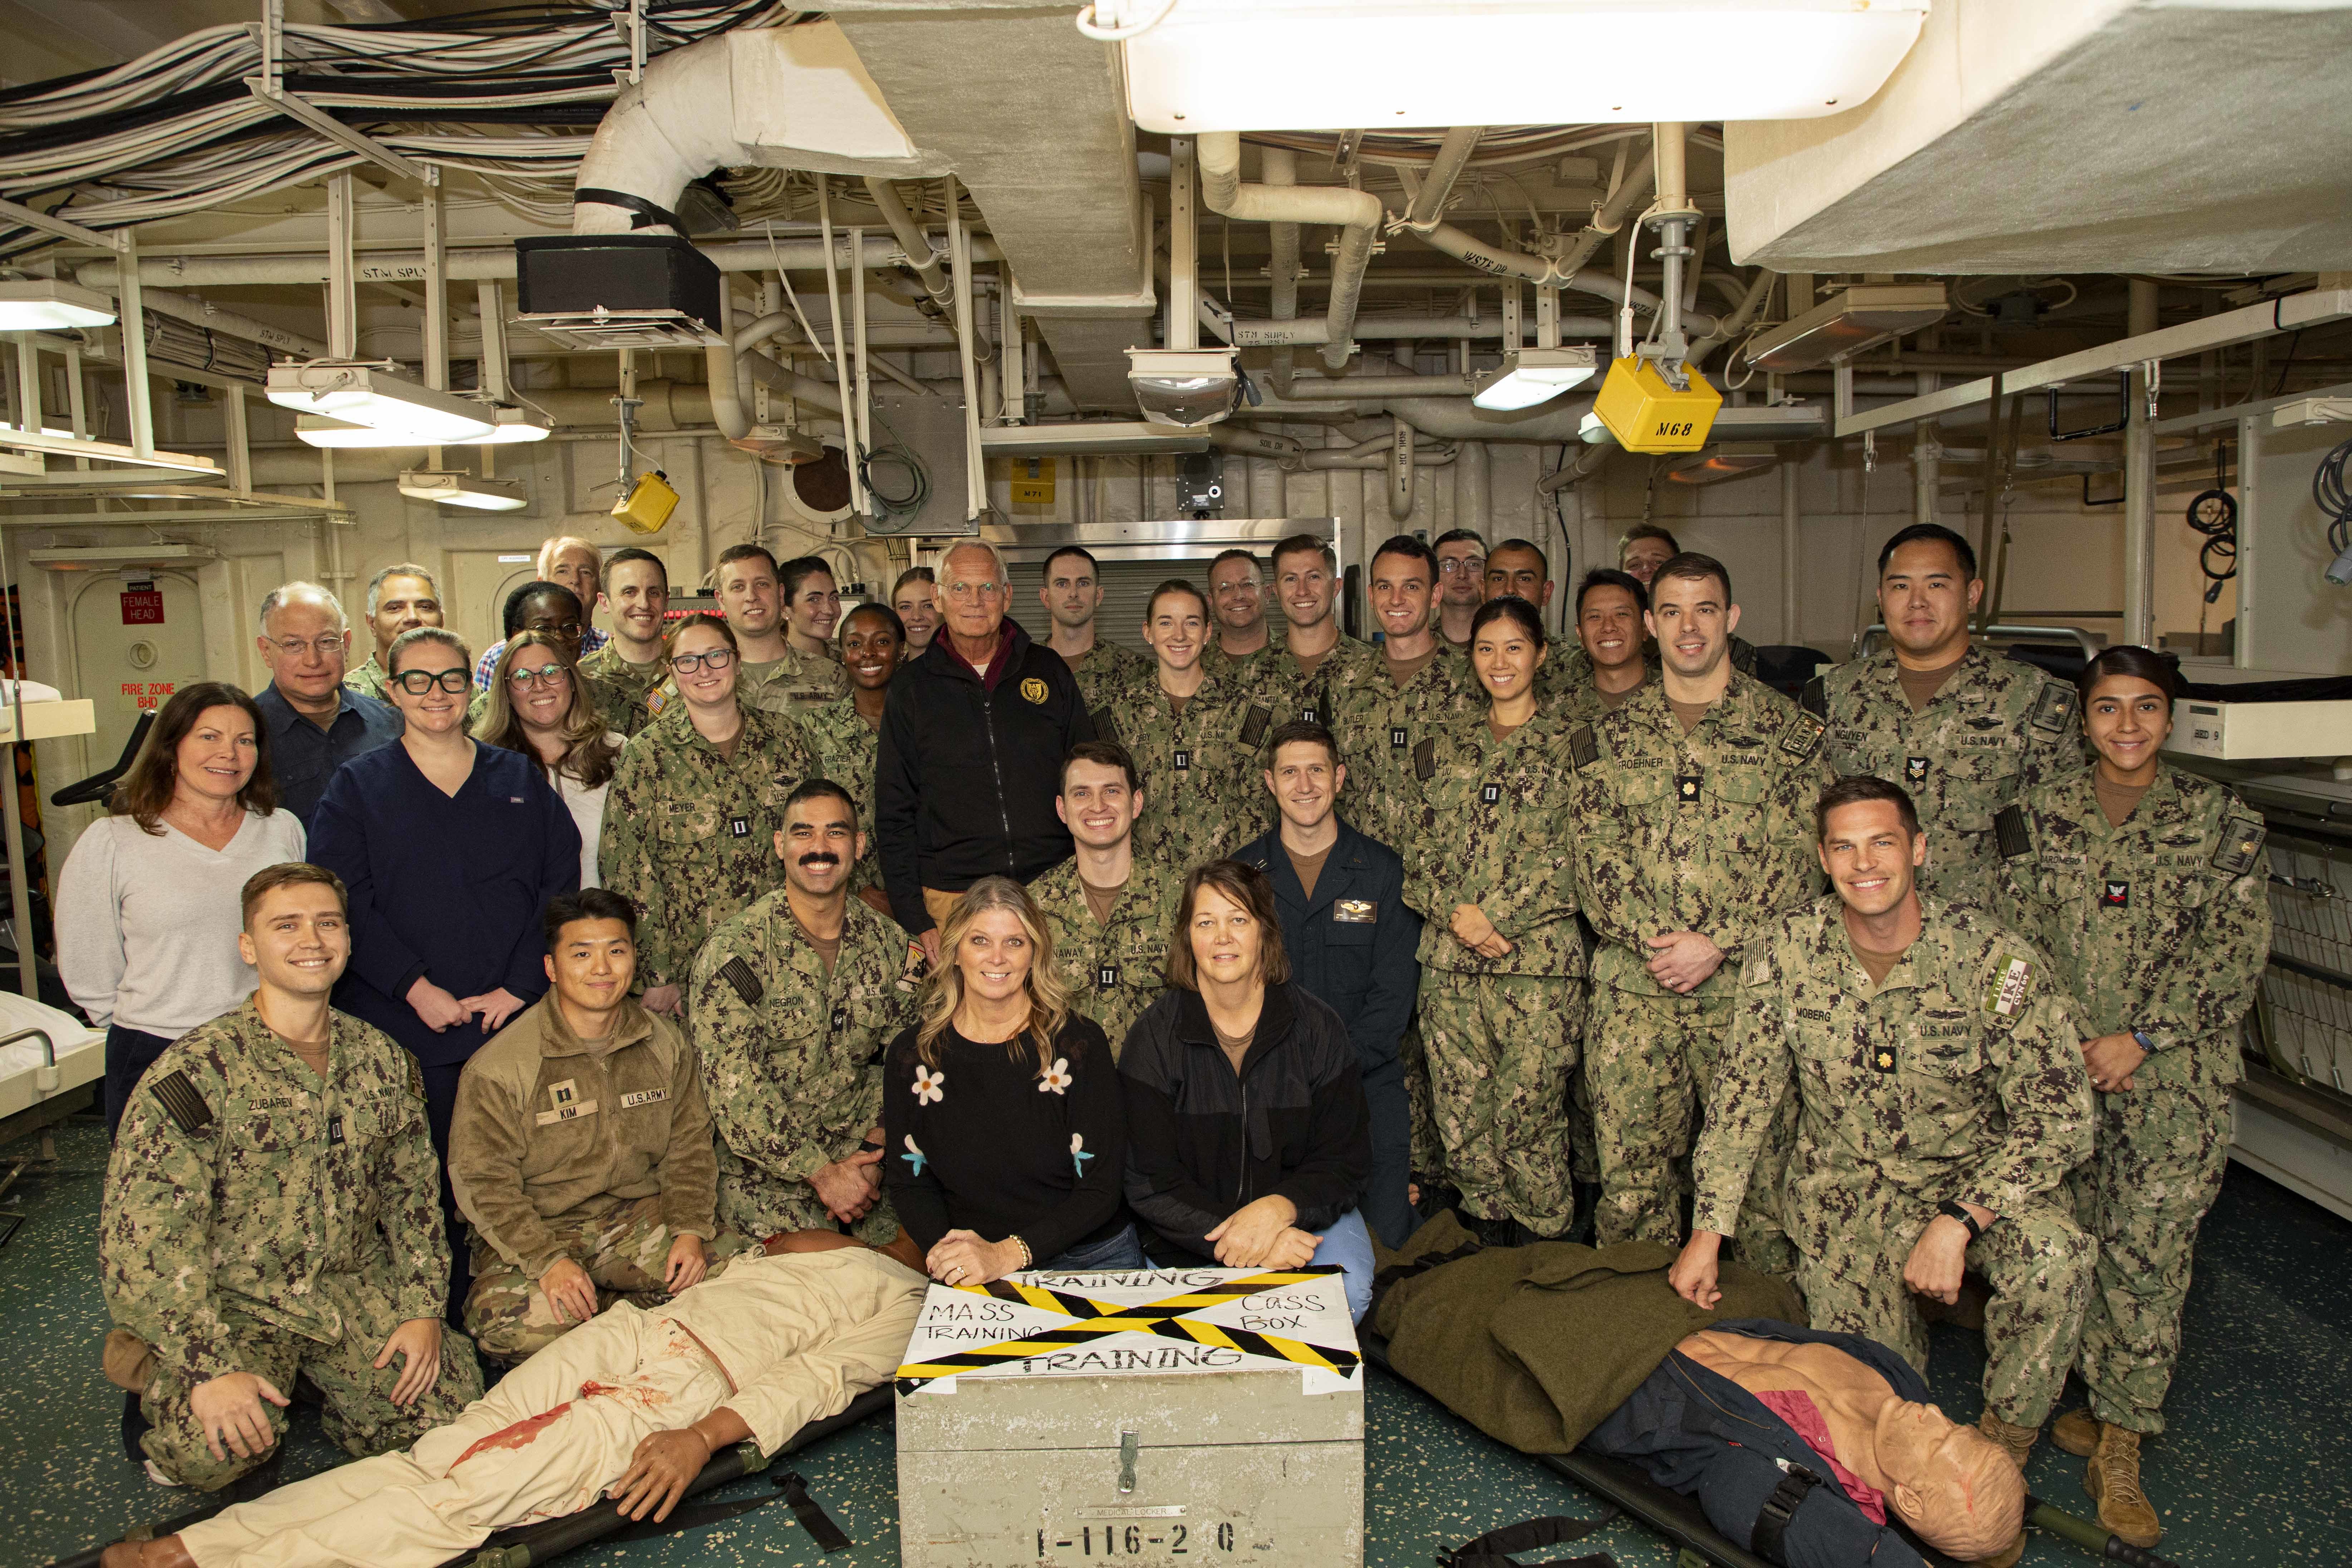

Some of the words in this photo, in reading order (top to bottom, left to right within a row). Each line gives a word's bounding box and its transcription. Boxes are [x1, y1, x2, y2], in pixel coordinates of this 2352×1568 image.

[1462, 251, 1494, 270] WSTE
[363, 268, 392, 278] STM
[1655, 422, 1693, 436] M68
[1259, 439, 1272, 448] SOIL
[123, 596, 160, 607] FEMALE
[130, 609, 155, 619] HEAD
[121, 683, 143, 695] FIRE
[148, 683, 175, 695] ZONE
[137, 696, 158, 708] BHD
[1343, 715, 1364, 725] BUTLER
[1835, 729, 1868, 742] NGUYEN
[1961, 736, 1978, 746] U.S.
[1980, 736, 2007, 747] NAVY
[825, 754, 851, 763] FRAZIER
[1618, 758, 1663, 771] FROEHNER
[1721, 755, 1738, 764] U.S.
[1740, 755, 1766, 767] NAVY
[1442, 767, 1452, 776] LIU
[1525, 766, 1540, 774] U.S.
[1542, 765, 1556, 780] NAVY
[669, 802, 695, 813] MEYER
[2156, 856, 2173, 866] U.S.
[2177, 855, 2203, 867] NAVY
[1131, 945, 1145, 955] U.S.
[1147, 943, 1169, 953] NAVY
[1995, 969, 2008, 990] LIKE
[866, 987, 877, 996] U.S.
[2001, 969, 2021, 1003] IKE
[2013, 987, 2025, 1005] CVN
[2020, 974, 2029, 986] 69
[769, 996, 804, 1008] NEGRON
[1796, 1007, 1831, 1022] MOBERG
[1920, 1026, 1939, 1037] U.S.
[1942, 1025, 1972, 1036] NAVY
[363, 1091, 376, 1101] U.S.
[378, 1087, 396, 1099] NAVY
[248, 1097, 293, 1111] ZUBAREV
[560, 1110, 577, 1120] KIM
[1021, 1269, 1224, 1289] TRAINING
[929, 1303, 1015, 1321] MASS
[1015, 1346, 1242, 1373] TRAINING
